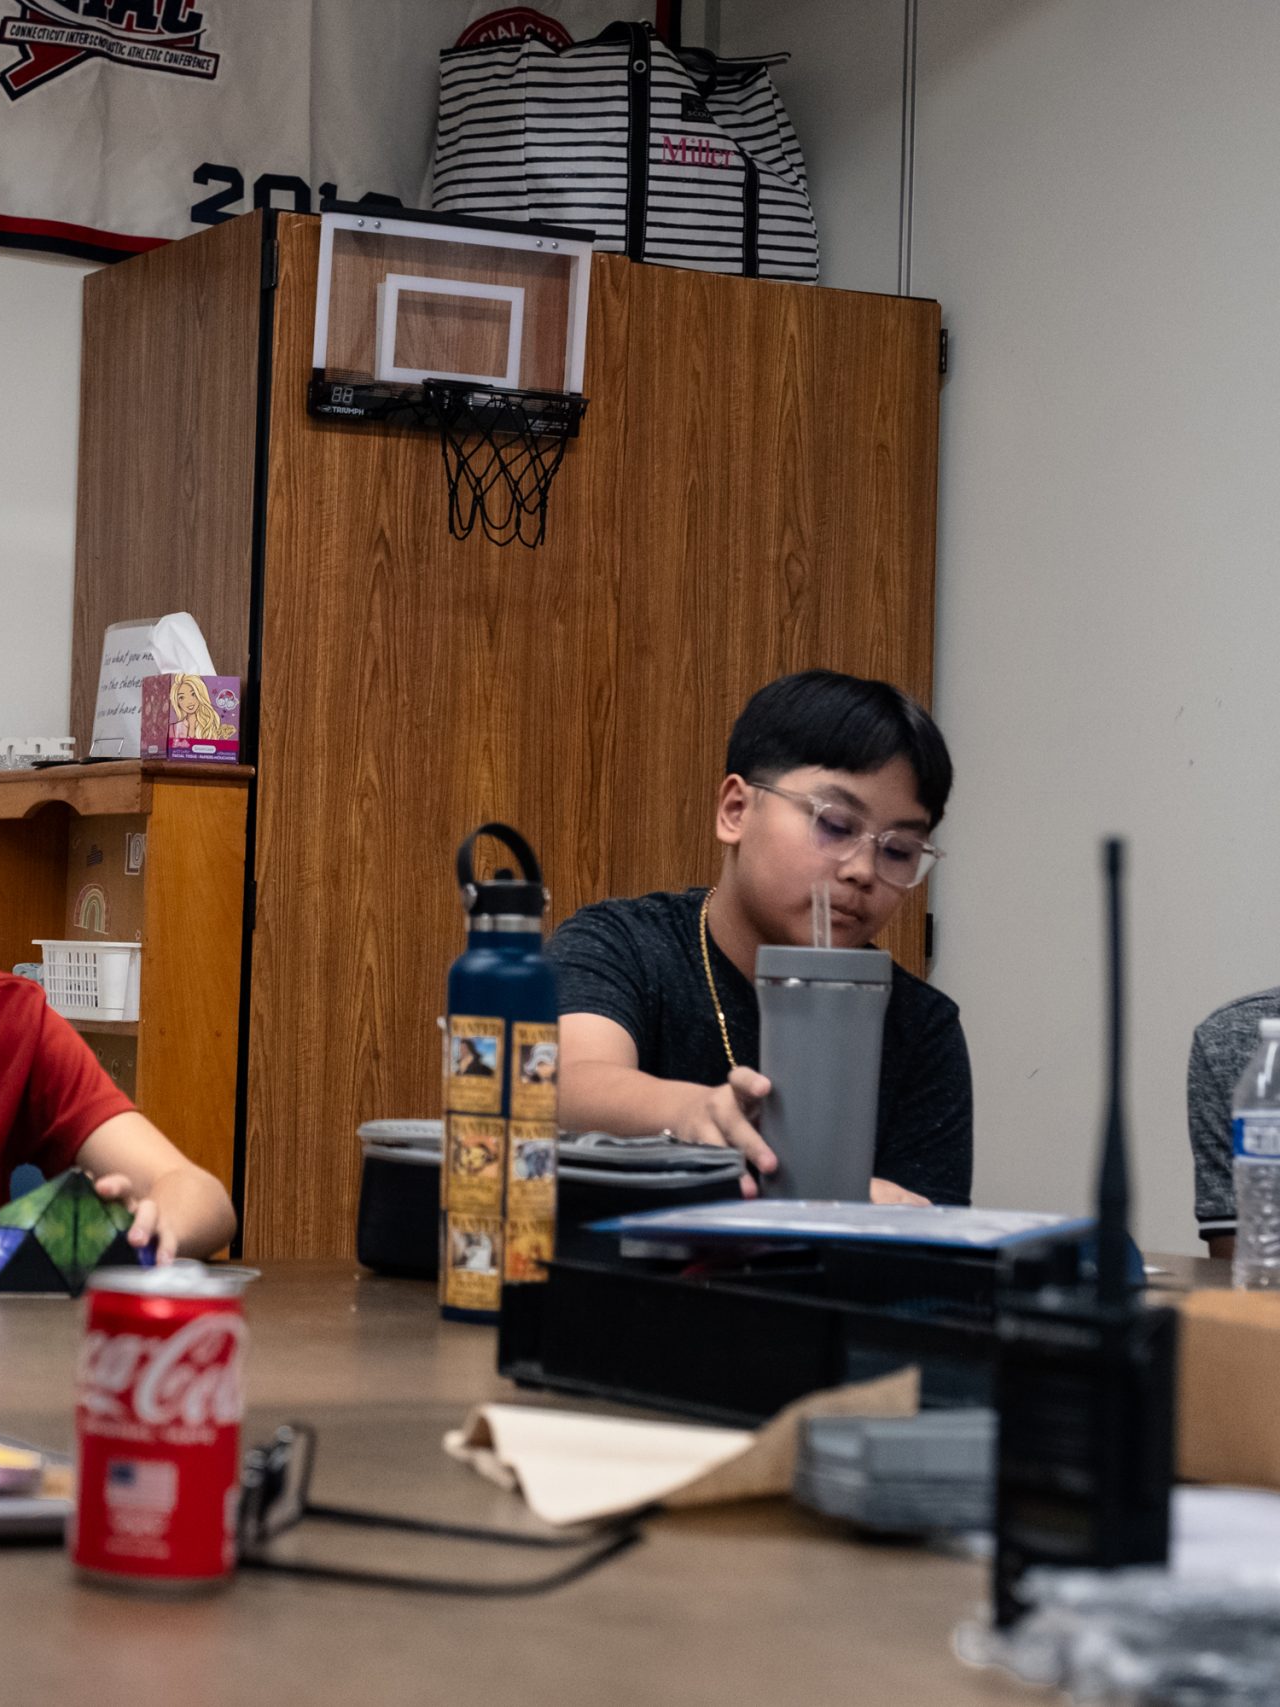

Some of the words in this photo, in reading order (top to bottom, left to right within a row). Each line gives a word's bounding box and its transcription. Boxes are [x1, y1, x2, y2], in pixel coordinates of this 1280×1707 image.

[10, 24, 65, 42] CONNECTICUT
[127, 46, 163, 62] ATHLETIC
[163, 50, 213, 71] CONFERENCE
[661, 135, 735, 168] Miller
